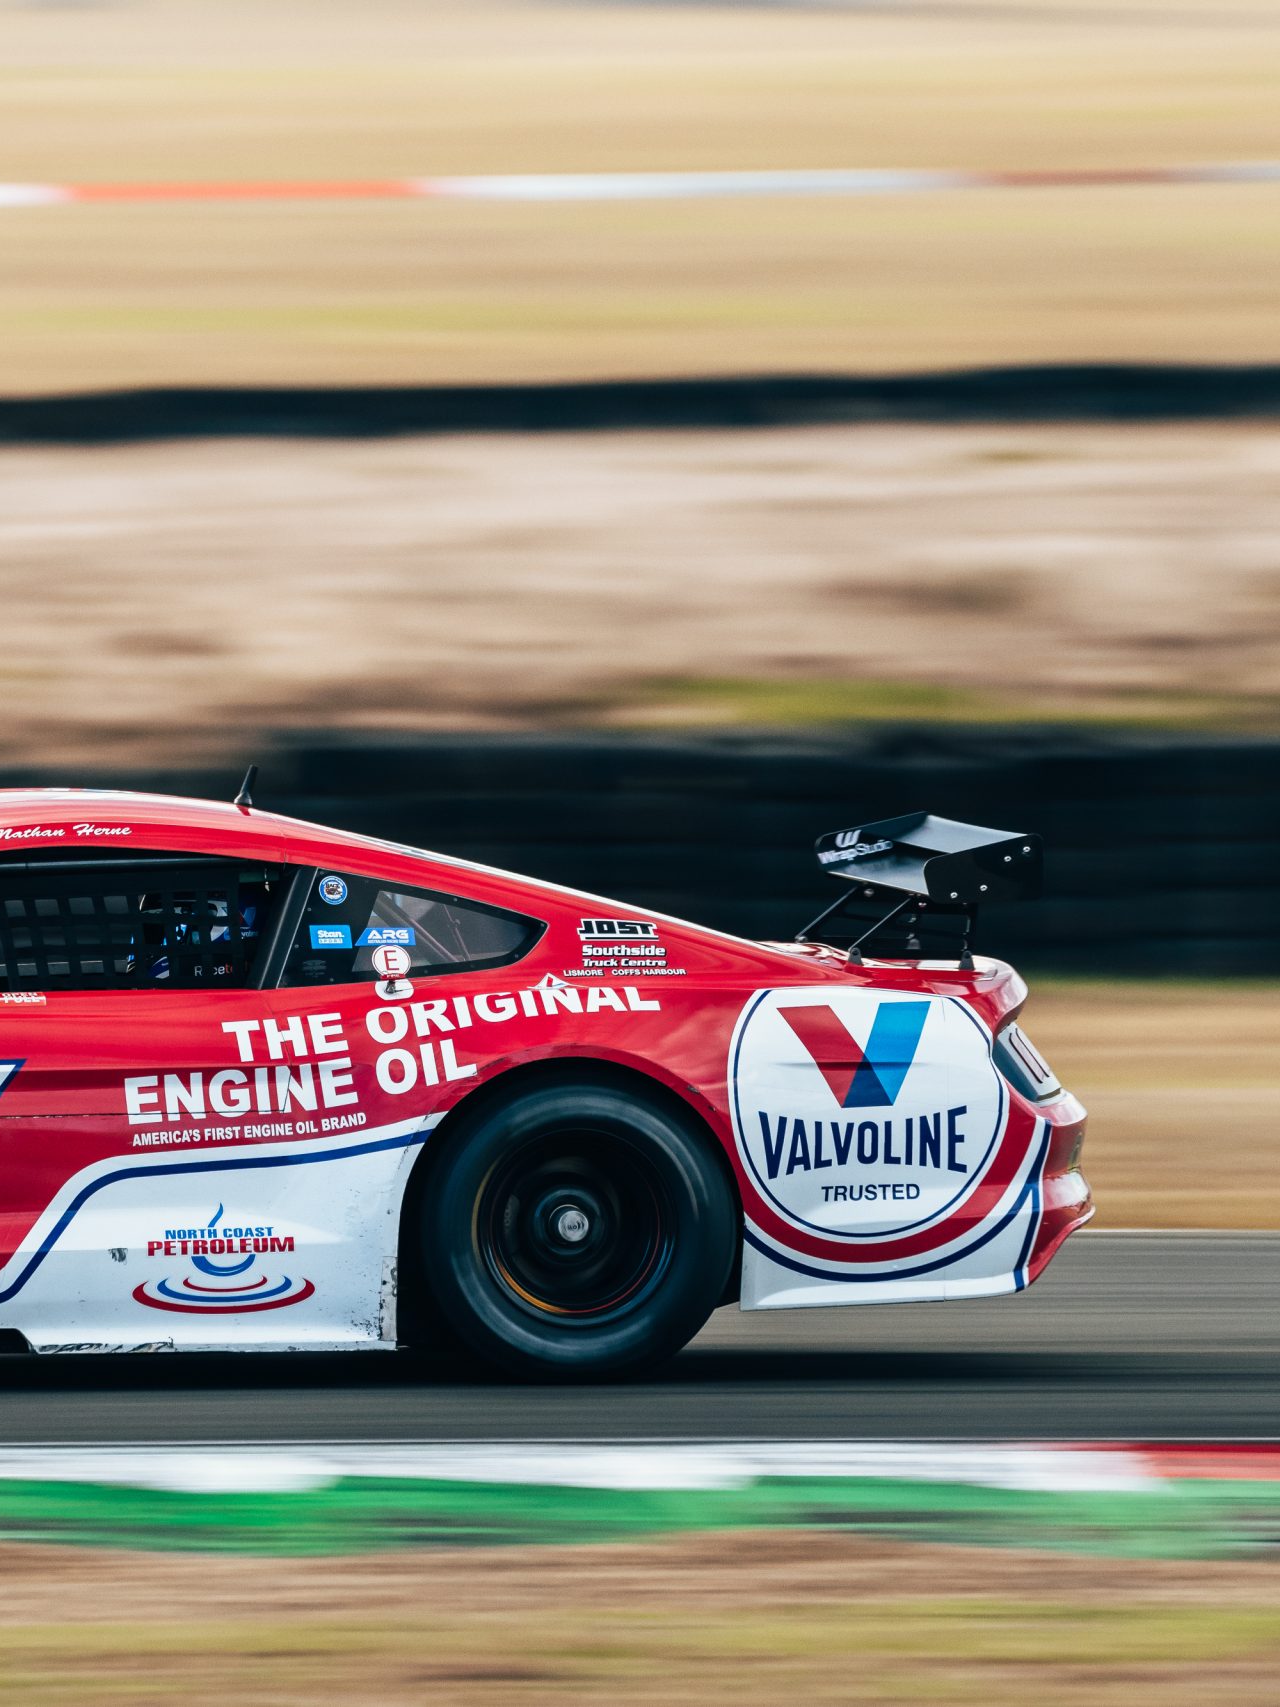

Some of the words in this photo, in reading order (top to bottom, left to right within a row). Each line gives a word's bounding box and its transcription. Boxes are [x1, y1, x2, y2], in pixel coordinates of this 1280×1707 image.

[73, 823, 132, 836] Herne
[367, 929, 409, 940] ARG
[577, 919, 656, 936] JOST
[582, 945, 666, 957] Southside
[383, 950, 400, 971] E
[582, 958, 618, 967] Truck
[620, 958, 667, 967] Centre
[563, 969, 605, 977] LISMORE
[611, 968, 641, 976] COFFS
[642, 968, 687, 976] HARBOUR
[221, 1012, 349, 1063] THE
[365, 986, 661, 1044] ORIGINAL
[124, 1056, 359, 1125] ENGINE
[376, 1038, 478, 1095] OIL
[132, 1129, 200, 1147] AMERICA'S
[204, 1126, 240, 1141] FIRST
[244, 1123, 293, 1139] ENGINE
[295, 1120, 318, 1135] OIL
[321, 1112, 367, 1131] BRAND
[758, 1105, 968, 1180] VALVOLINE
[821, 1183, 921, 1202] TRUSTED
[165, 1228, 217, 1239] NORTH
[223, 1226, 274, 1238] COAST
[147, 1236, 295, 1257] PETROLEUM
